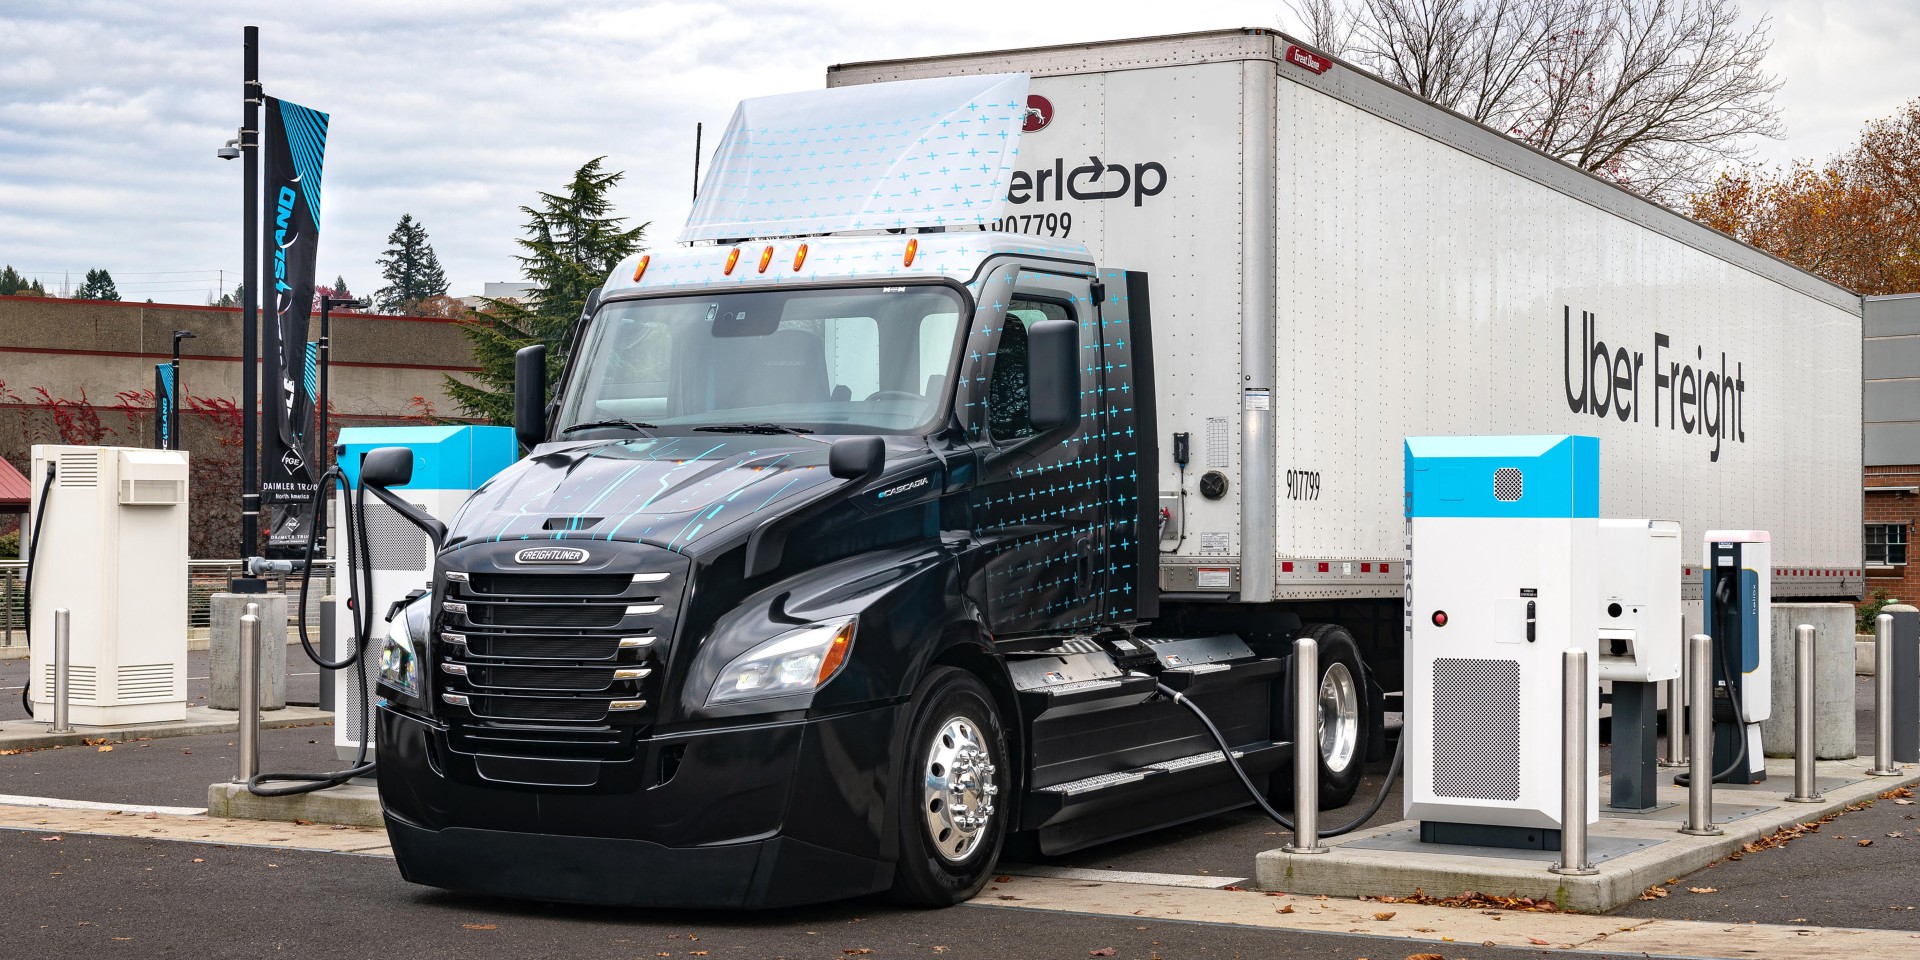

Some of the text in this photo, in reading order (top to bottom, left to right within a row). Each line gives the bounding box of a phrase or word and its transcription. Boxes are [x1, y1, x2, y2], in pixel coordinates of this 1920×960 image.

[1294, 49, 1308, 65] Great
[1564, 305, 1746, 463] Uber Freight
[263, 482, 295, 491] DAIMLER
[1286, 469, 1321, 501] 907799
[521, 550, 581, 560] FREIGHTLINER
[1405, 491, 1413, 640] DETROIT
